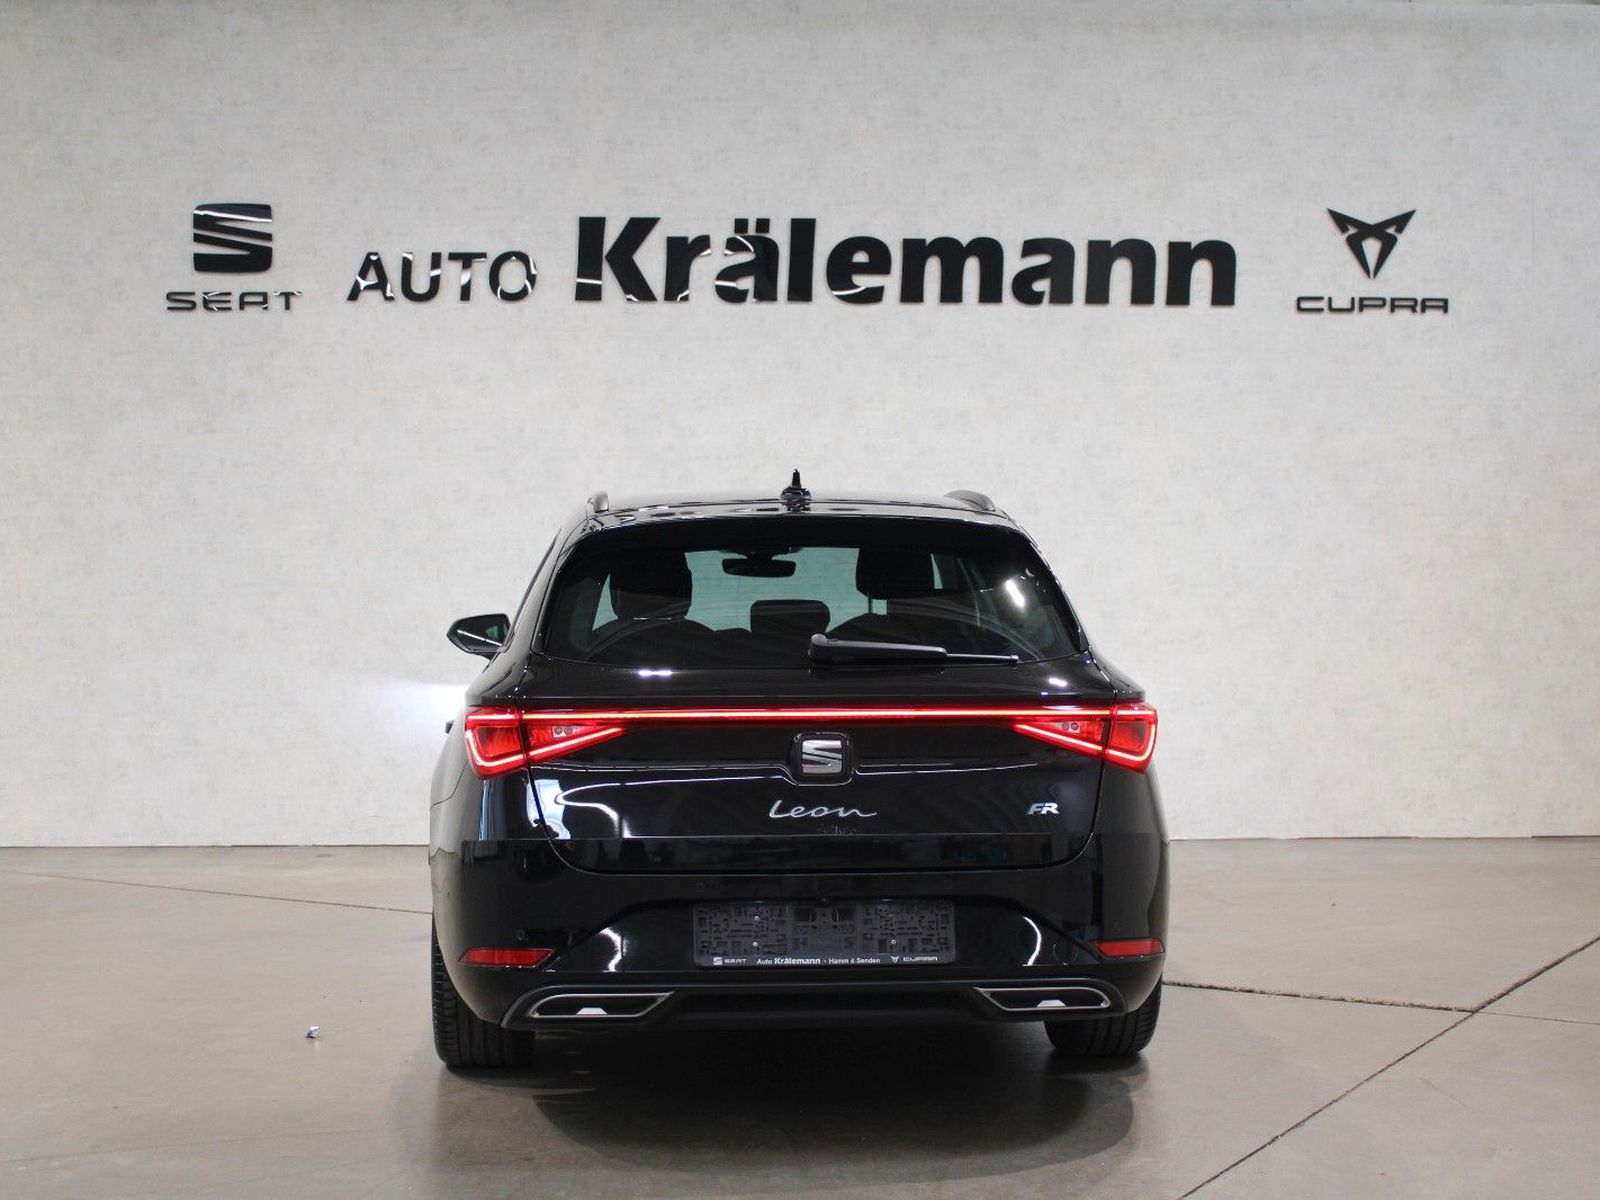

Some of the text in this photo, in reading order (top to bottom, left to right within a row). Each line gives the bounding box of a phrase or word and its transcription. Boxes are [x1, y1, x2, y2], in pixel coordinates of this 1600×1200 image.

[347, 216, 1237, 306] AUTO Krälemann
[166, 290, 302, 311] SEAT
[1296, 296, 1449, 314] CUPRA
[768, 799, 878, 819] Leon
[1028, 802, 1060, 816] FR
[756, 958, 773, 966] Auto
